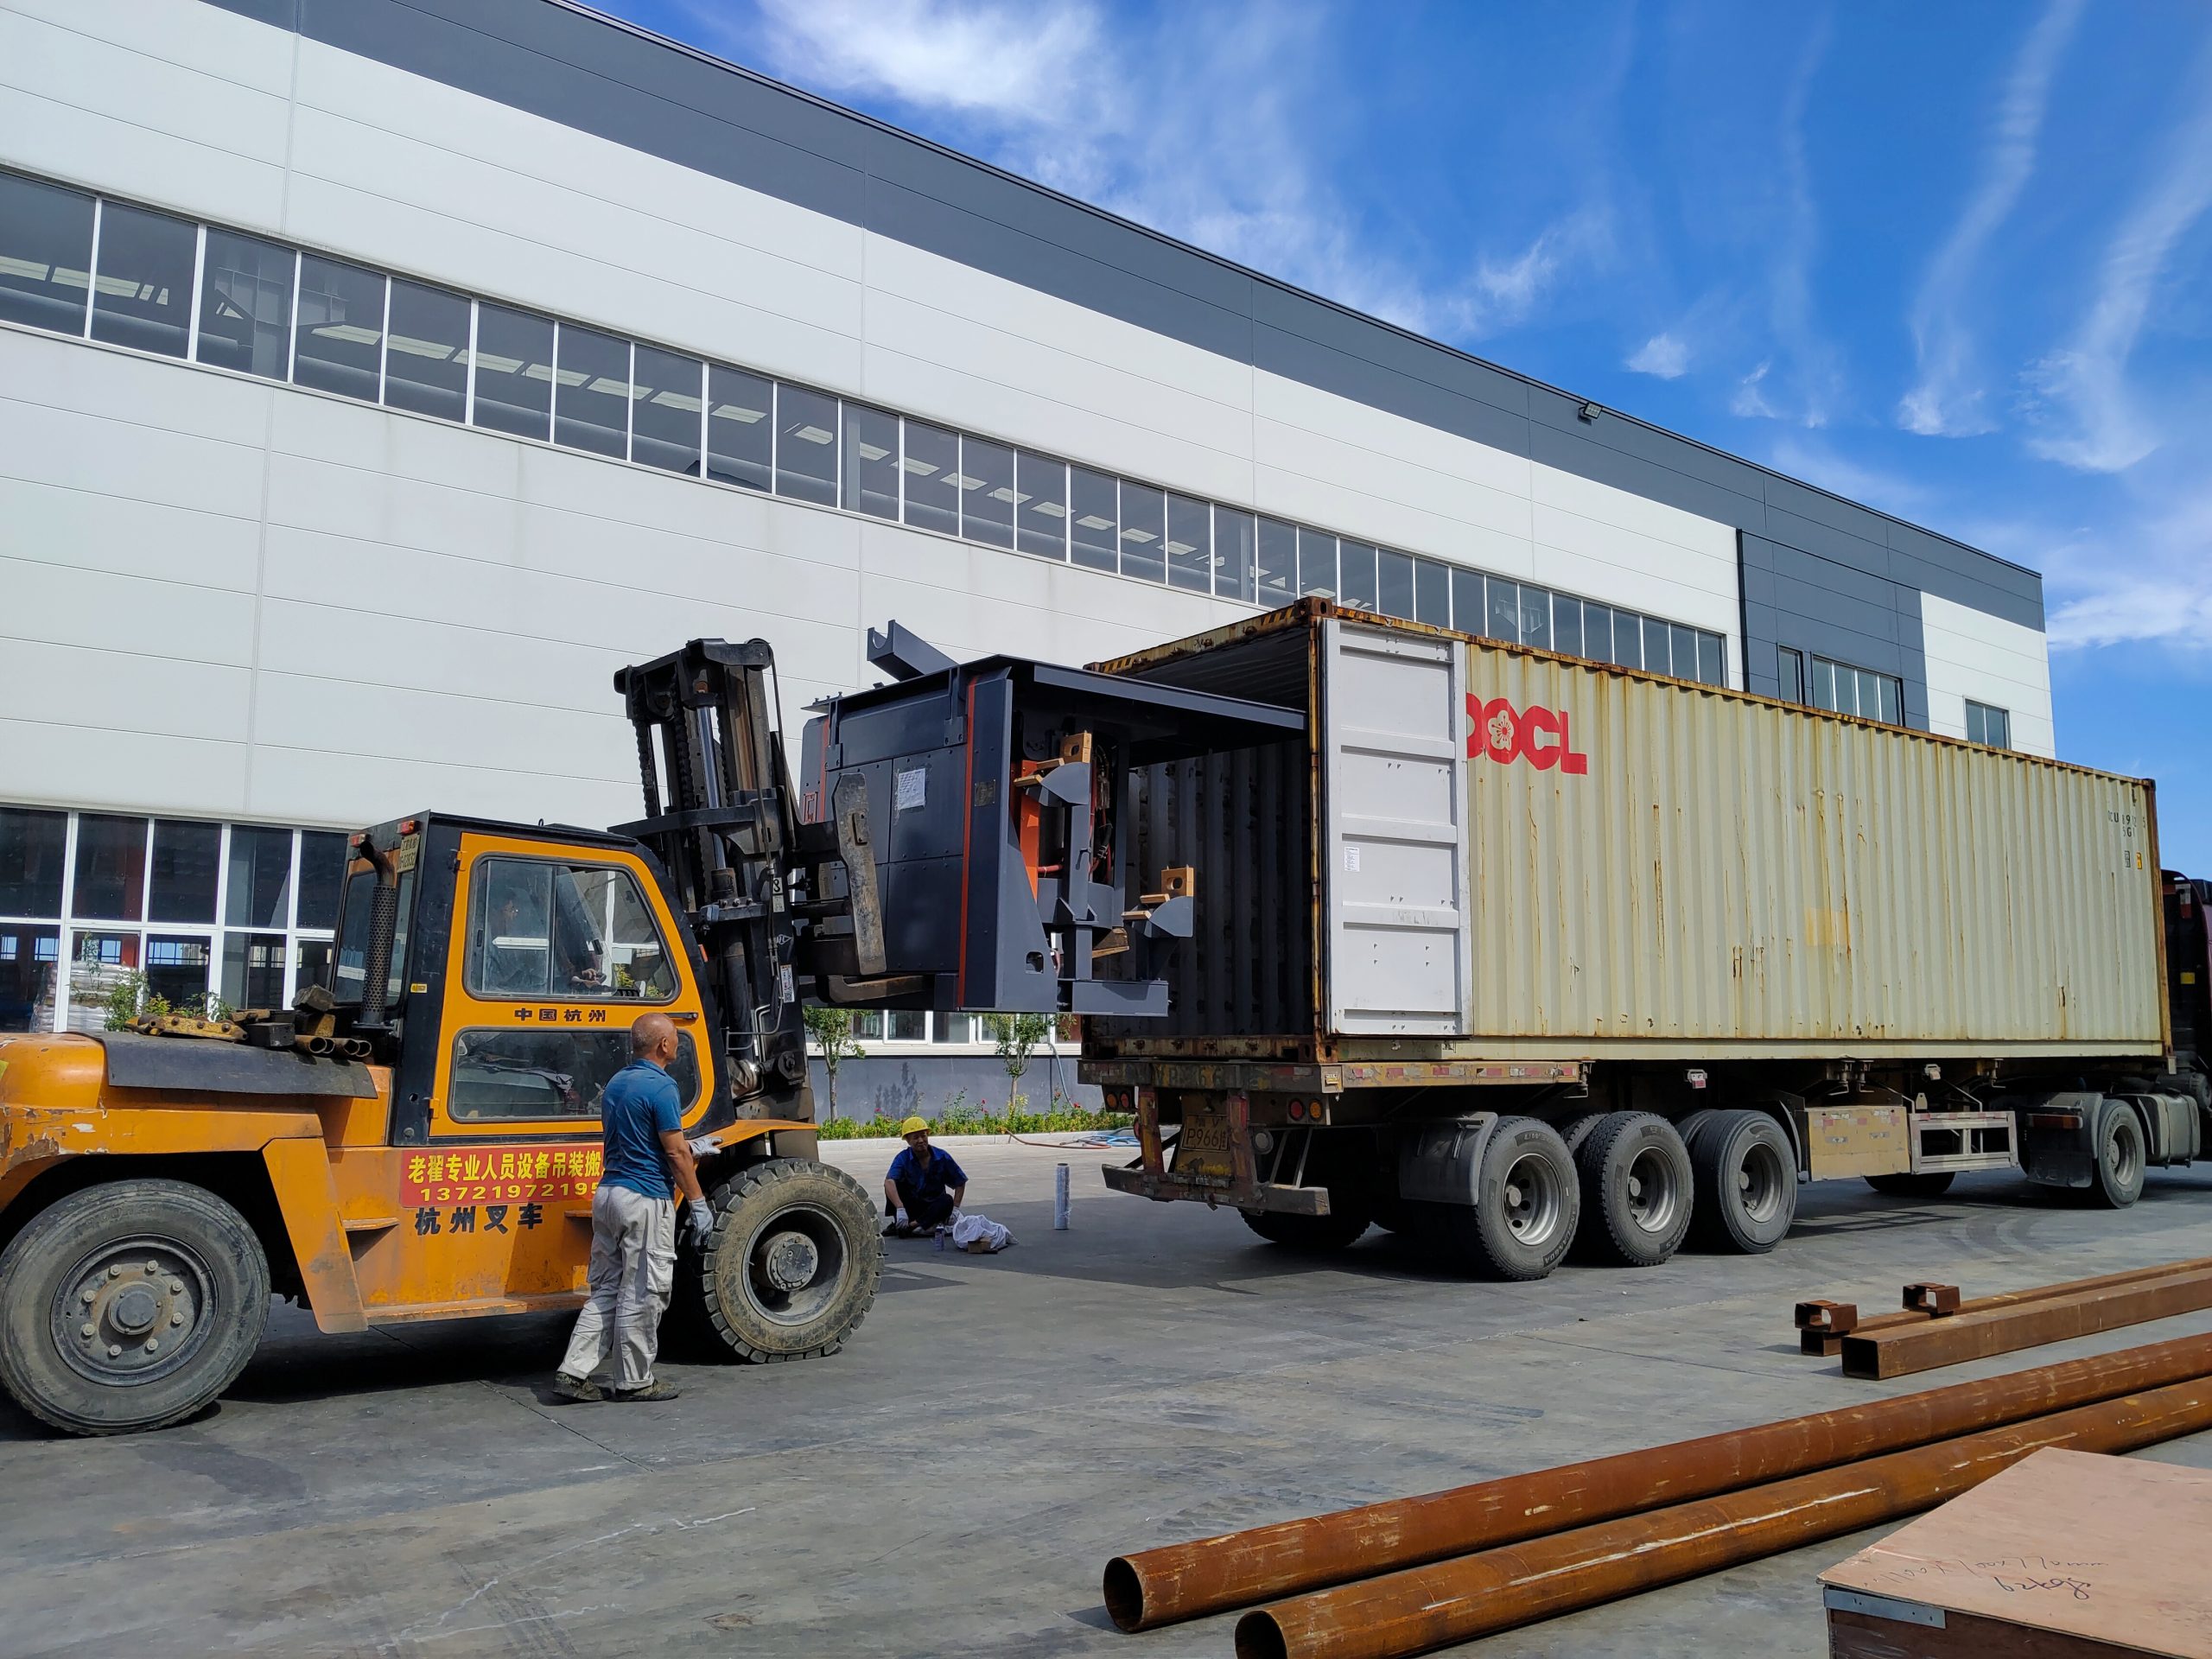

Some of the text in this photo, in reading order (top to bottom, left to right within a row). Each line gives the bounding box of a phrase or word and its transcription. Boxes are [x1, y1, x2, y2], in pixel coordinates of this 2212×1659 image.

[514, 1007, 606, 1023] 中国杭州
[408, 1150, 605, 1184] 老翟专业人员设备吊装搬
[415, 1203, 543, 1236] 杭州叉车
